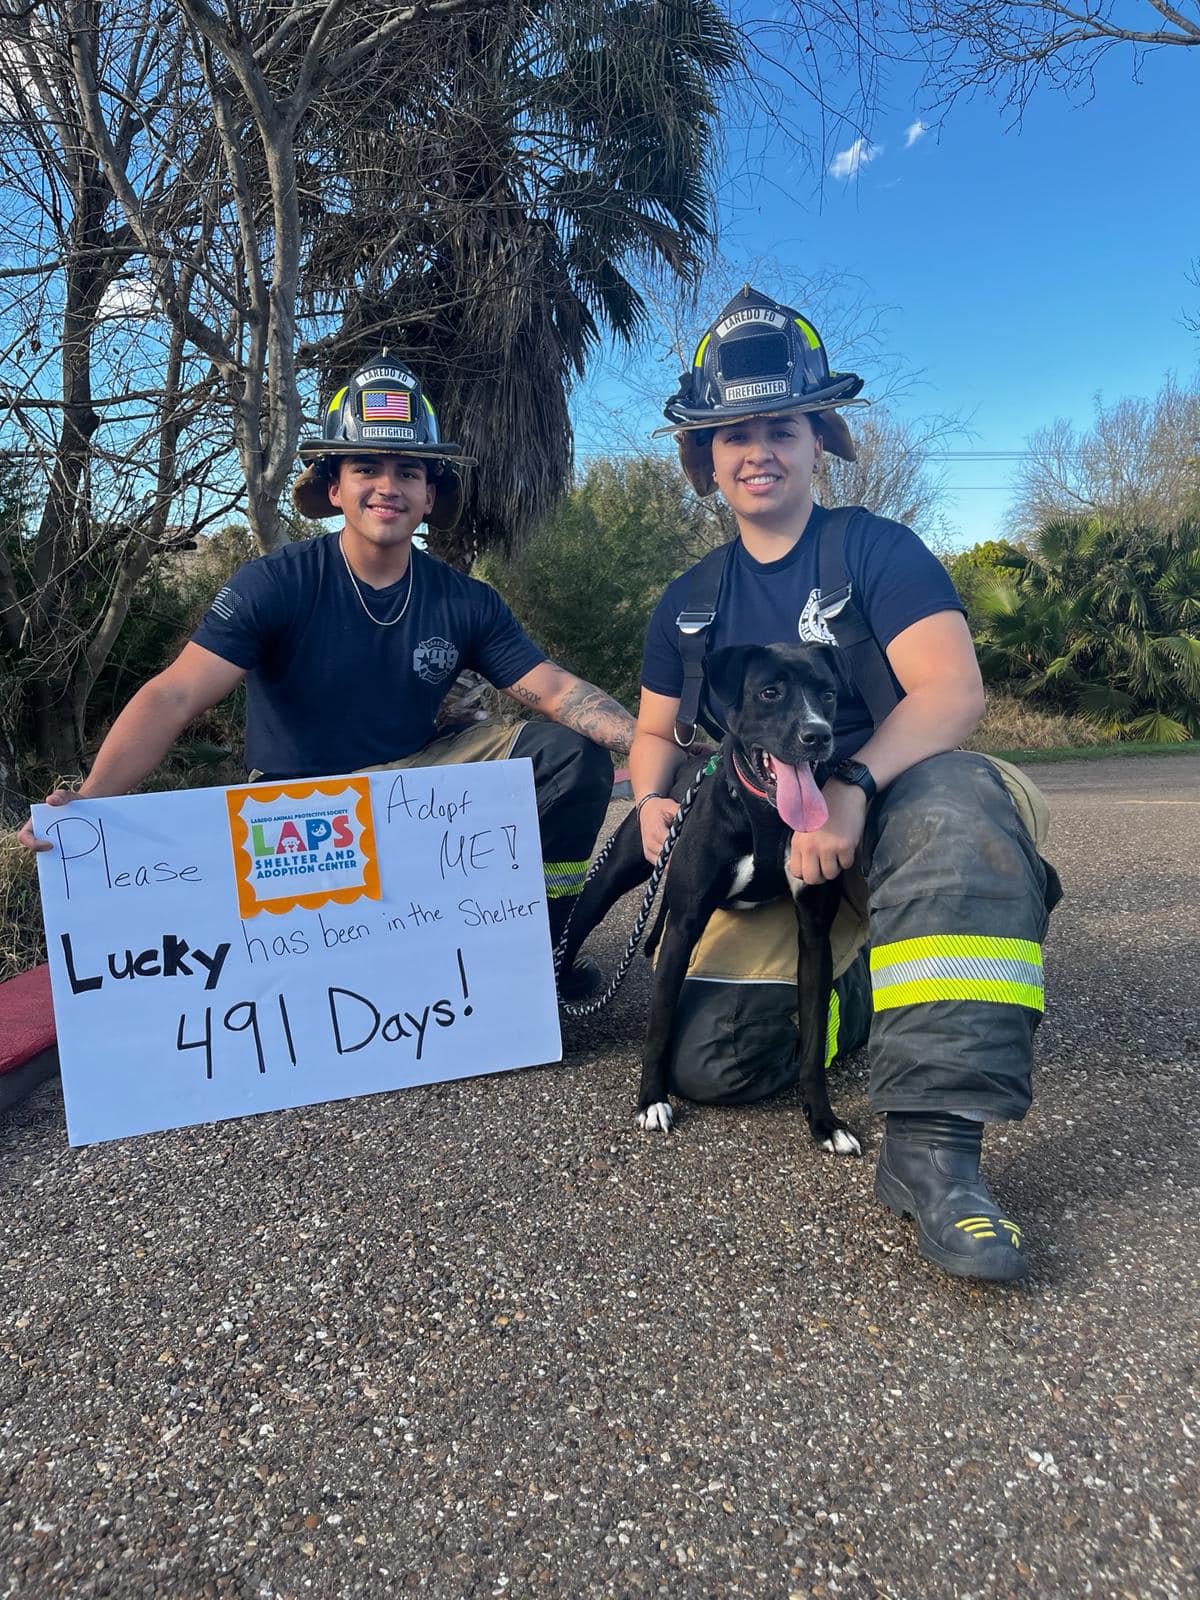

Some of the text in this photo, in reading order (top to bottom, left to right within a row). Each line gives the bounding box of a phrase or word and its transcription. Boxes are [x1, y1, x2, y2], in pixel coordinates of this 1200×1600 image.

[724, 308, 776, 330] LAREDO FD
[363, 367, 396, 381] LAREDO
[727, 381, 785, 400] FIREFIGHTER
[364, 427, 412, 438] FIREFIGHTER
[386, 774, 473, 824] Adopt
[250, 808, 348, 824] LAREDO ANIMAL PROTECTIVE SOCIETY
[251, 815, 354, 857] LAPS
[45, 816, 203, 900] Please
[255, 849, 355, 870] SHELTER AND
[256, 859, 357, 879] ADOPTION CENTER
[60, 898, 541, 995] Lucky has been in the Shelter
[176, 947, 474, 1080] 491 Days!
